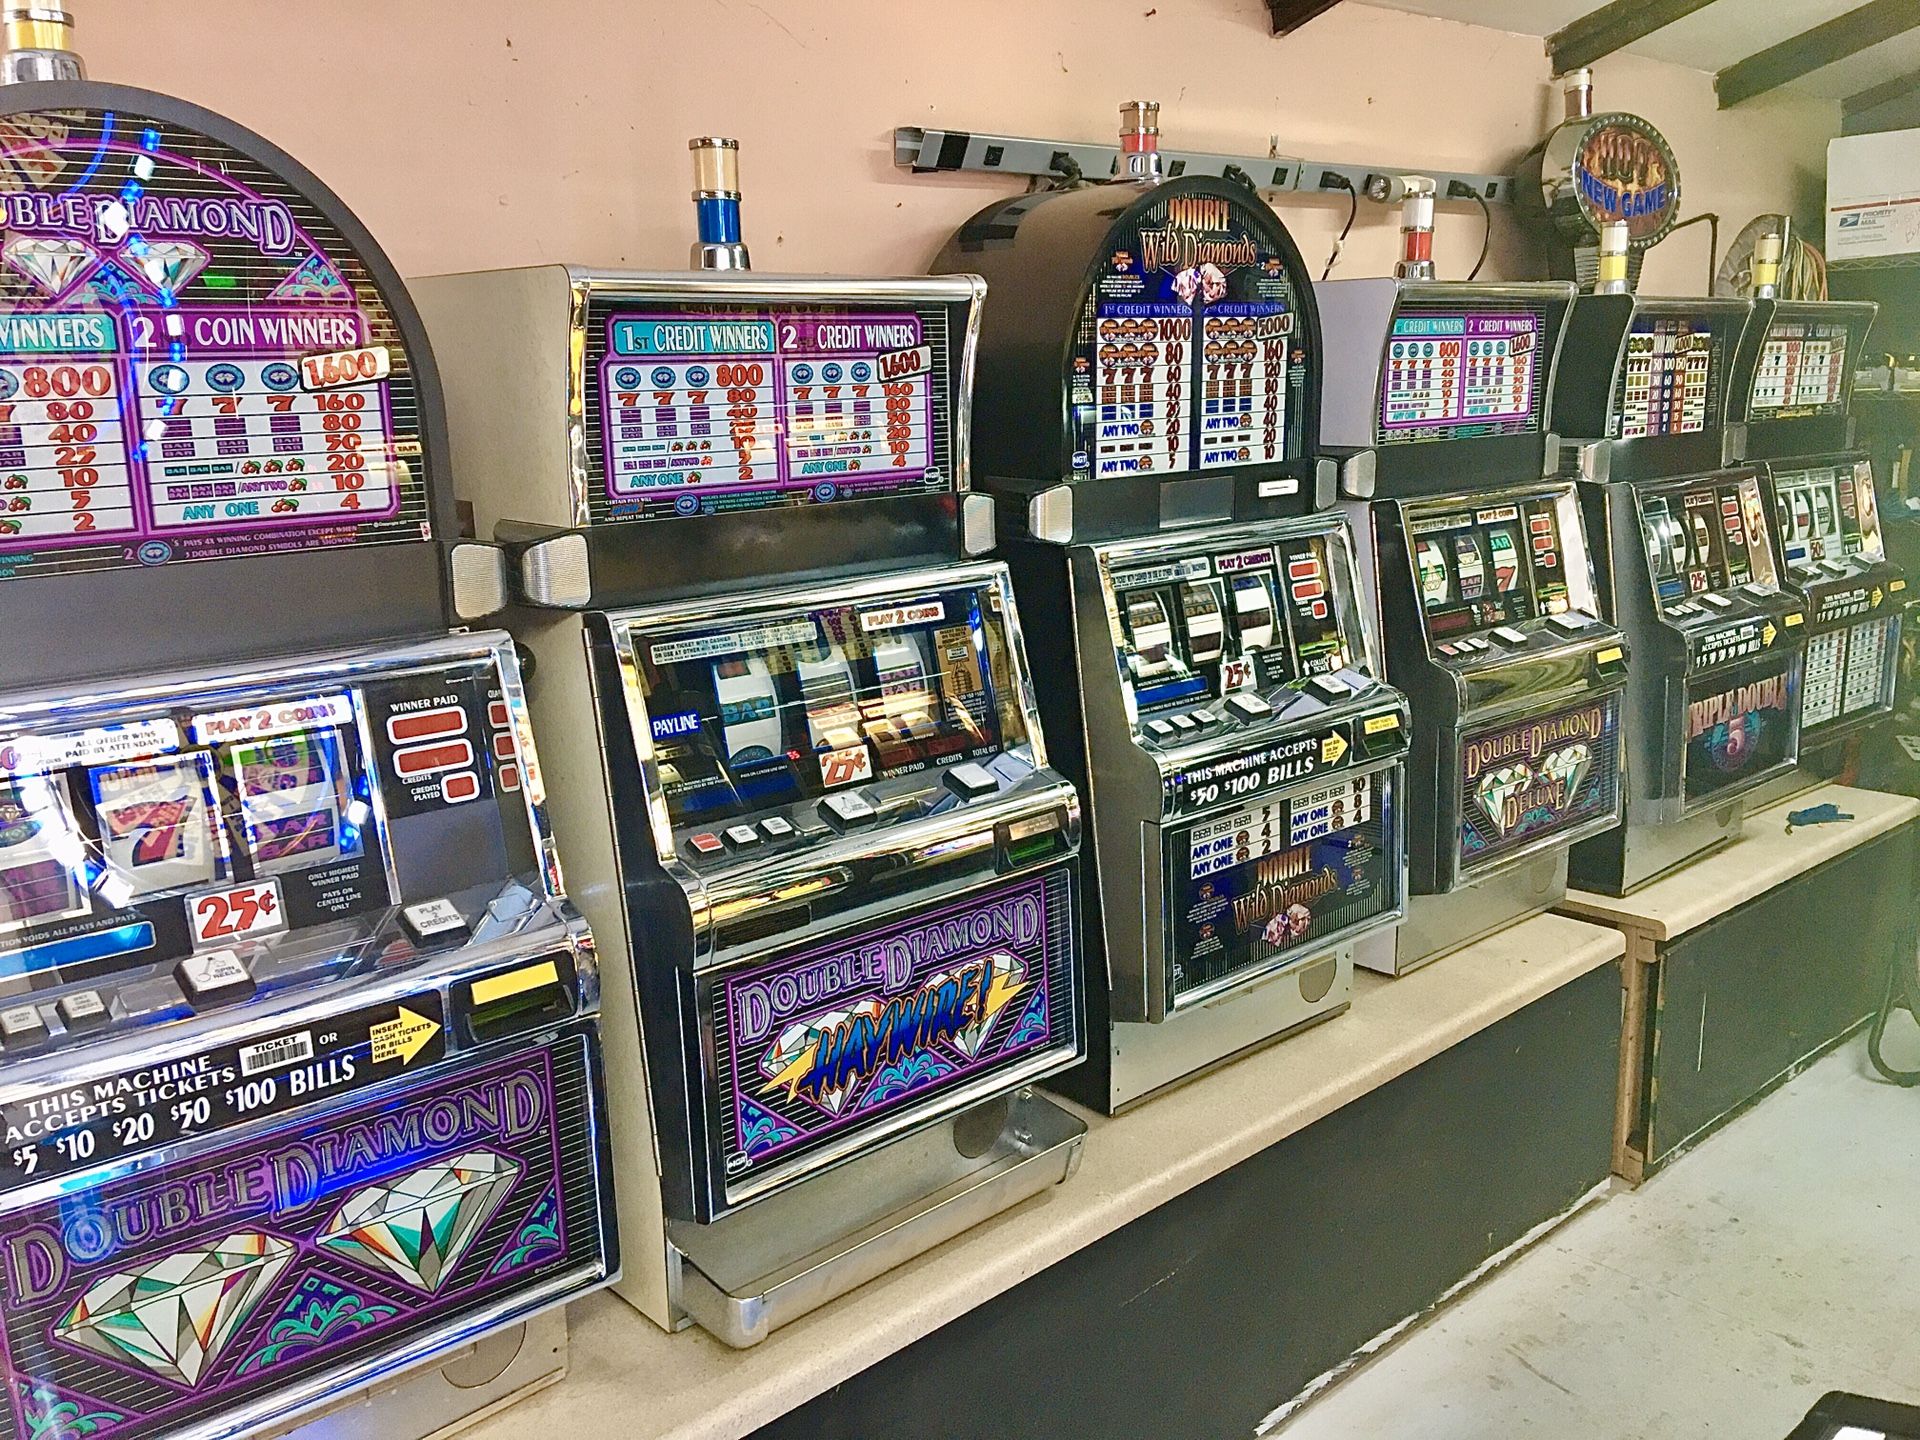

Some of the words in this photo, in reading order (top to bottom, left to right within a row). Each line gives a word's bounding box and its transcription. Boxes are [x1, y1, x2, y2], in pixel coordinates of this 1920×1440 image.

[1582, 168, 1617, 213] NEW
[1622, 182, 1666, 217] GAME
[0, 196, 88, 231] BLE
[1169, 198, 1230, 232] DOUBLE
[1141, 222, 1179, 272] Wild
[1183, 232, 1255, 268] Diamonds
[1117, 304, 1150, 315] CREDIT
[1154, 304, 1192, 314] WINNERS
[1218, 304, 1248, 315] CREDIT
[195, 317, 255, 347] COIN
[260, 318, 357, 347] WINNERS
[817, 324, 861, 349] CREDIT
[864, 324, 915, 348] WINNERS
[1158, 318, 1191, 341] 1000
[1404, 320, 1430, 333] CREDIT
[1479, 320, 1504, 332] CREDIT
[1505, 319, 1533, 332] WINNERS
[653, 324, 706, 352] CREDIT
[709, 324, 769, 351] WINNERS
[1439, 341, 1460, 357] 800
[1263, 338, 1284, 362] 160
[22, 365, 112, 398] 800
[716, 363, 764, 387] 800
[882, 383, 914, 397] 160
[46, 401, 94, 421] 80
[313, 393, 365, 411] 160
[630, 474, 658, 488] ANY
[657, 471, 685, 485] ONE
[738, 466, 754, 481] 2
[182, 505, 216, 521] ANY
[225, 501, 260, 517] ONE
[183, 538, 203, 547] PAYS
[216, 534, 252, 544] WINNING
[253, 529, 306, 541] COMBINATION
[307, 526, 334, 536] EXCEPT
[336, 525, 358, 534] WHEN
[191, 548, 224, 558] DOUBLE
[225, 544, 266, 555] DIAMOND
[268, 541, 303, 552] SYMBOLS
[305, 538, 320, 547] ARE
[322, 535, 357, 546] SHOWING
[1218, 559, 1236, 570] PLAY
[1237, 555, 1243, 569] 2
[867, 613, 893, 627] PLAY
[896, 610, 905, 625] 2
[907, 606, 940, 621] COINS
[1225, 661, 1251, 689] 25¢
[390, 698, 431, 713] WINNER
[433, 694, 459, 707] PAID
[206, 716, 251, 736] PLAY
[256, 711, 272, 730] 2
[652, 713, 699, 737] PAYLINE
[65, 748, 90, 758] PAID
[108, 737, 165, 752] ATTENDANT
[96, 734, 129, 745] OTHER
[131, 730, 156, 740] WINS
[1467, 729, 1530, 779] DOUBLE
[1530, 707, 1601, 759] DIAMOND
[908, 761, 925, 773] PAID
[936, 752, 963, 766] CREDITS
[1186, 767, 1213, 785] THIS
[1214, 751, 1267, 777] MACHINE
[1269, 738, 1318, 760] ACCEPTS
[402, 774, 432, 785] CREDITS
[411, 783, 441, 796] CREDITS
[1190, 784, 1219, 806] $50
[1224, 774, 1261, 796] $100
[1267, 756, 1315, 785] BILLS
[413, 791, 441, 802] PLAYED
[1505, 779, 1565, 829] DELUXE
[308, 871, 328, 881] ONLY
[329, 864, 360, 878] HIGHEST
[1257, 845, 1313, 886] DOUBLE
[311, 876, 340, 887] WINNER
[341, 872, 359, 882] PAID
[316, 896, 345, 908] CENTER
[346, 892, 362, 902] LINE
[322, 890, 341, 899] PAYS
[342, 887, 354, 895] ON
[1233, 882, 1268, 933] Wild
[1271, 866, 1337, 917] Diamonds
[197, 888, 277, 939] 25¢
[330, 903, 350, 913] ONLY
[418, 904, 442, 914] PLAY
[22, 932, 50, 942] VOIDS
[52, 928, 69, 937] ALL
[68, 922, 95, 934] PLAYS
[96, 918, 115, 928] AND
[116, 913, 136, 923] PAYS
[420, 913, 460, 929] CREDITS
[212, 967, 242, 980] REELS
[213, 965, 235, 975] SPIN
[742, 945, 884, 1041] DOUBLE
[886, 897, 1039, 990] DIAMOND
[372, 1021, 404, 1036] INSERT
[397, 1023, 431, 1038] TICKETS
[797, 956, 994, 1102] HAYWIRE!
[253, 1035, 298, 1054] TICKET
[319, 1032, 338, 1045] OR
[373, 1043, 387, 1052] OR
[388, 1036, 413, 1048] BILLS
[374, 1049, 398, 1060] HERE
[24, 1091, 86, 1119] THIS
[93, 1054, 213, 1101] MACHINE
[5, 1098, 127, 1144] ACCEPTS
[133, 1067, 236, 1107] TICKETS
[13, 1144, 39, 1176] $5
[56, 1129, 96, 1162] $10
[112, 1113, 155, 1146] $20
[170, 1096, 211, 1129] $50
[225, 1079, 277, 1113] $100
[290, 1054, 356, 1098] BILLS
[7, 1160, 269, 1305] DOUBLE
[270, 1074, 544, 1217] DIAMOND
